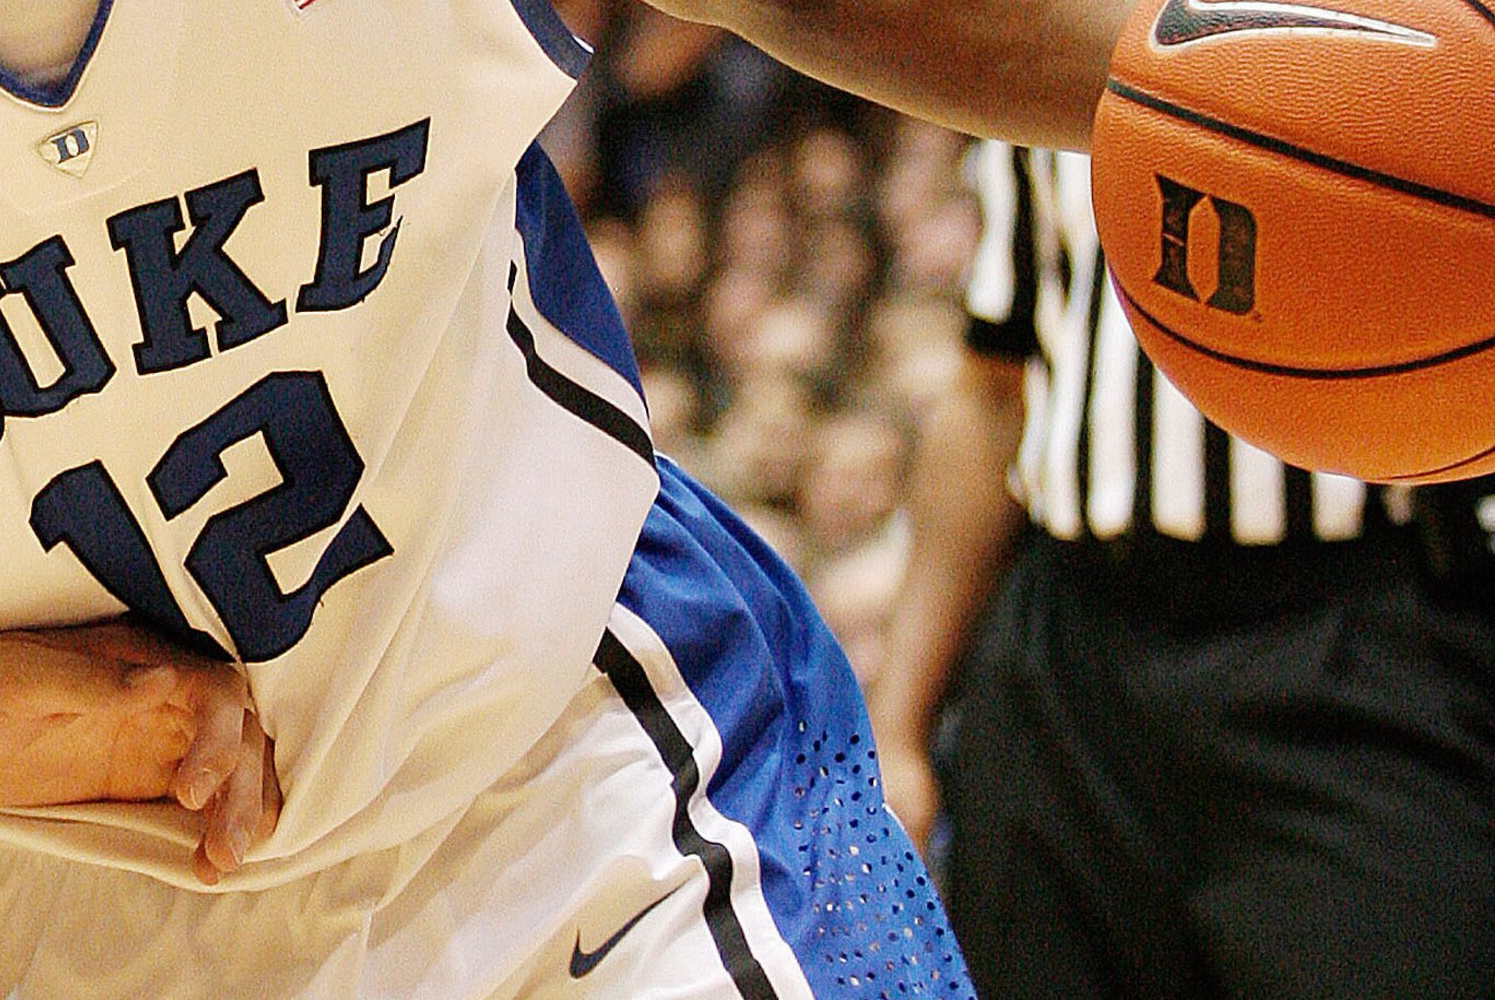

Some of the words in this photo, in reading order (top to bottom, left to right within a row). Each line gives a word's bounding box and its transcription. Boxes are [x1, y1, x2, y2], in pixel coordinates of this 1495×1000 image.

[50, 128, 90, 164] D
[1152, 173, 1258, 316] D
[29, 370, 395, 664] 12
